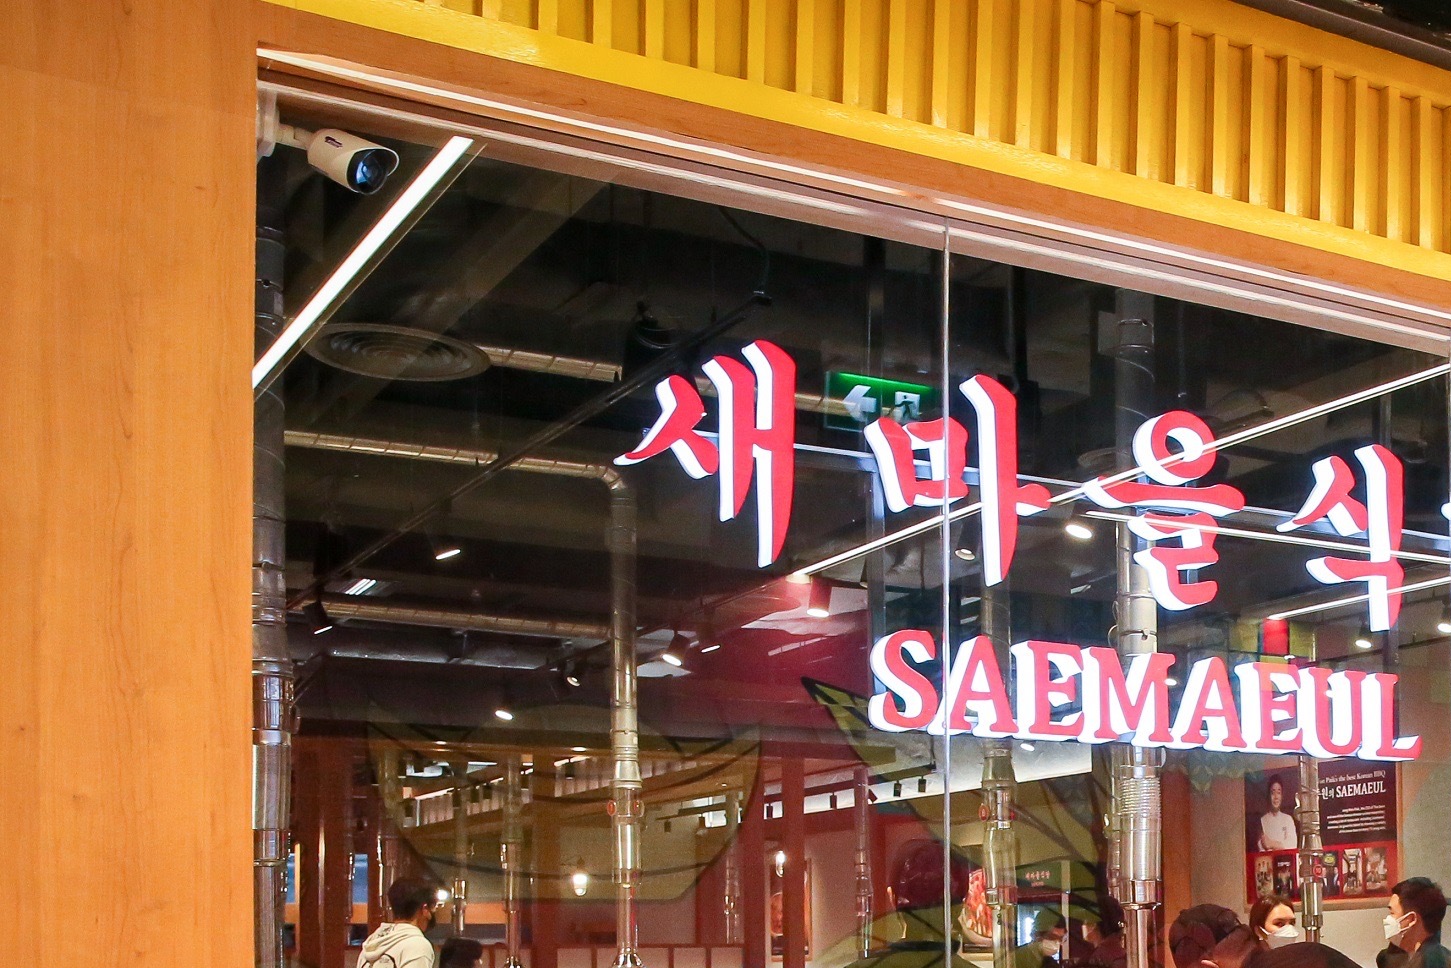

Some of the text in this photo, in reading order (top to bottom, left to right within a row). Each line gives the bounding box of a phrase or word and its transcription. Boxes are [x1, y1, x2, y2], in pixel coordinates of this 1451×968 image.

[867, 627, 1421, 762] SAEMAEUL
[1357, 772, 1373, 780] Korean
[1374, 770, 1386, 778] BBQ
[1336, 781, 1386, 798] SAEMAEUL
